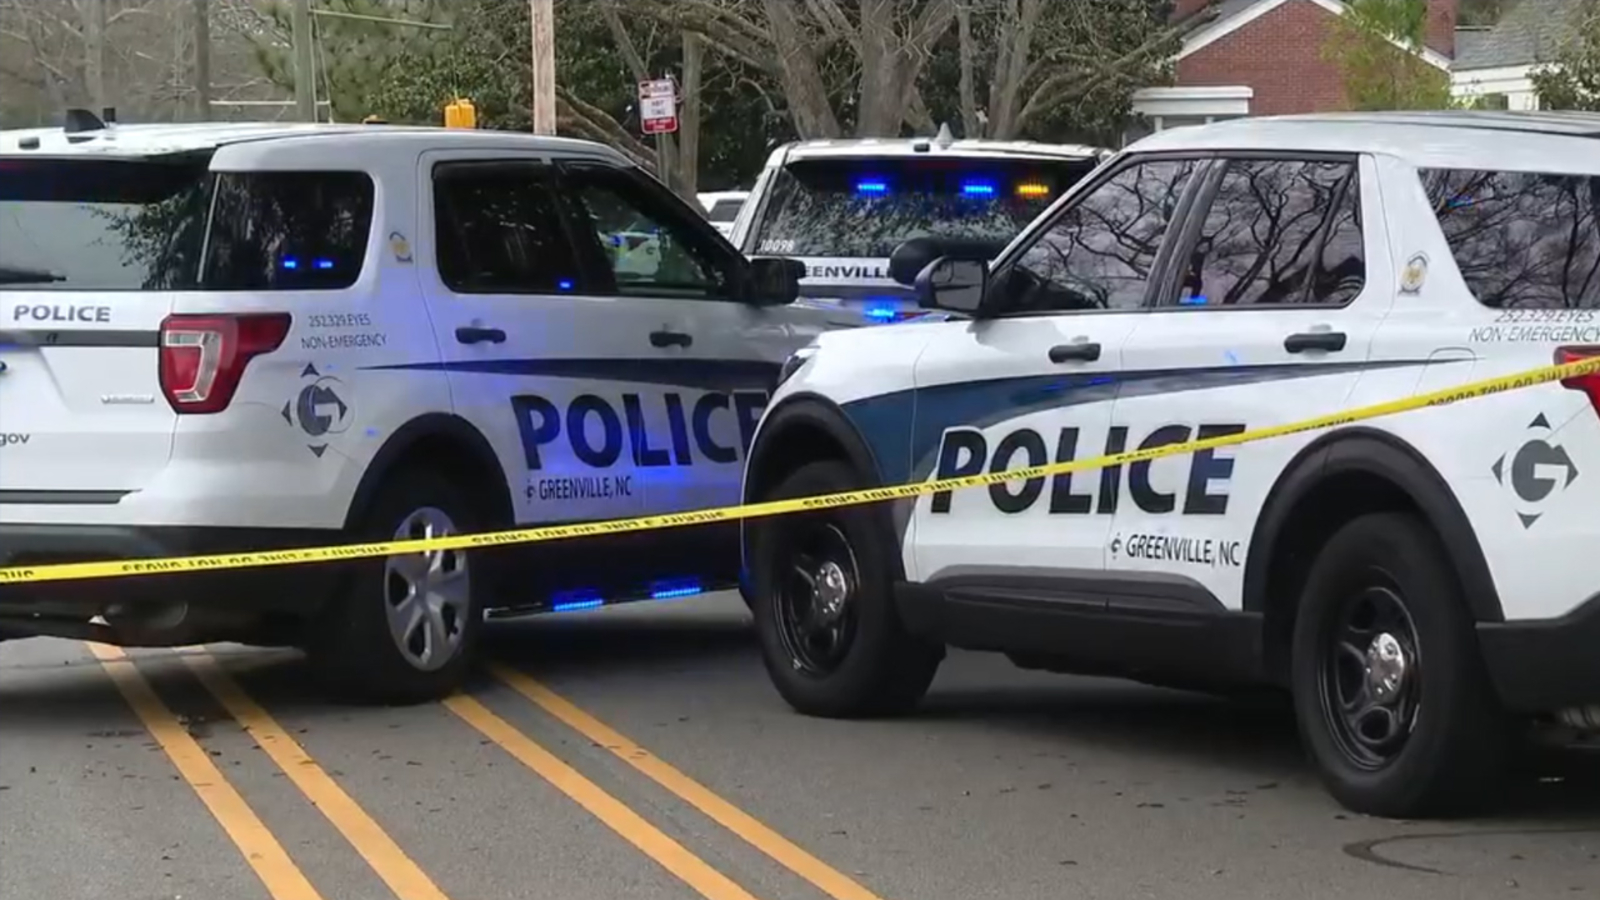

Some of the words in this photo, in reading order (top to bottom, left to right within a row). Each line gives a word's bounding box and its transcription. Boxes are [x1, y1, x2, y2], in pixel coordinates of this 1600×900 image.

[14, 305, 111, 322] POLICE
[301, 333, 387, 349] NON-EMERGENCY
[931, 424, 1246, 514] POLICE
[539, 477, 614, 500] GREENVILLE,
[615, 475, 632, 496] NC
[1126, 534, 1215, 568] GREENVILLE,
[1220, 541, 1240, 567] NC
